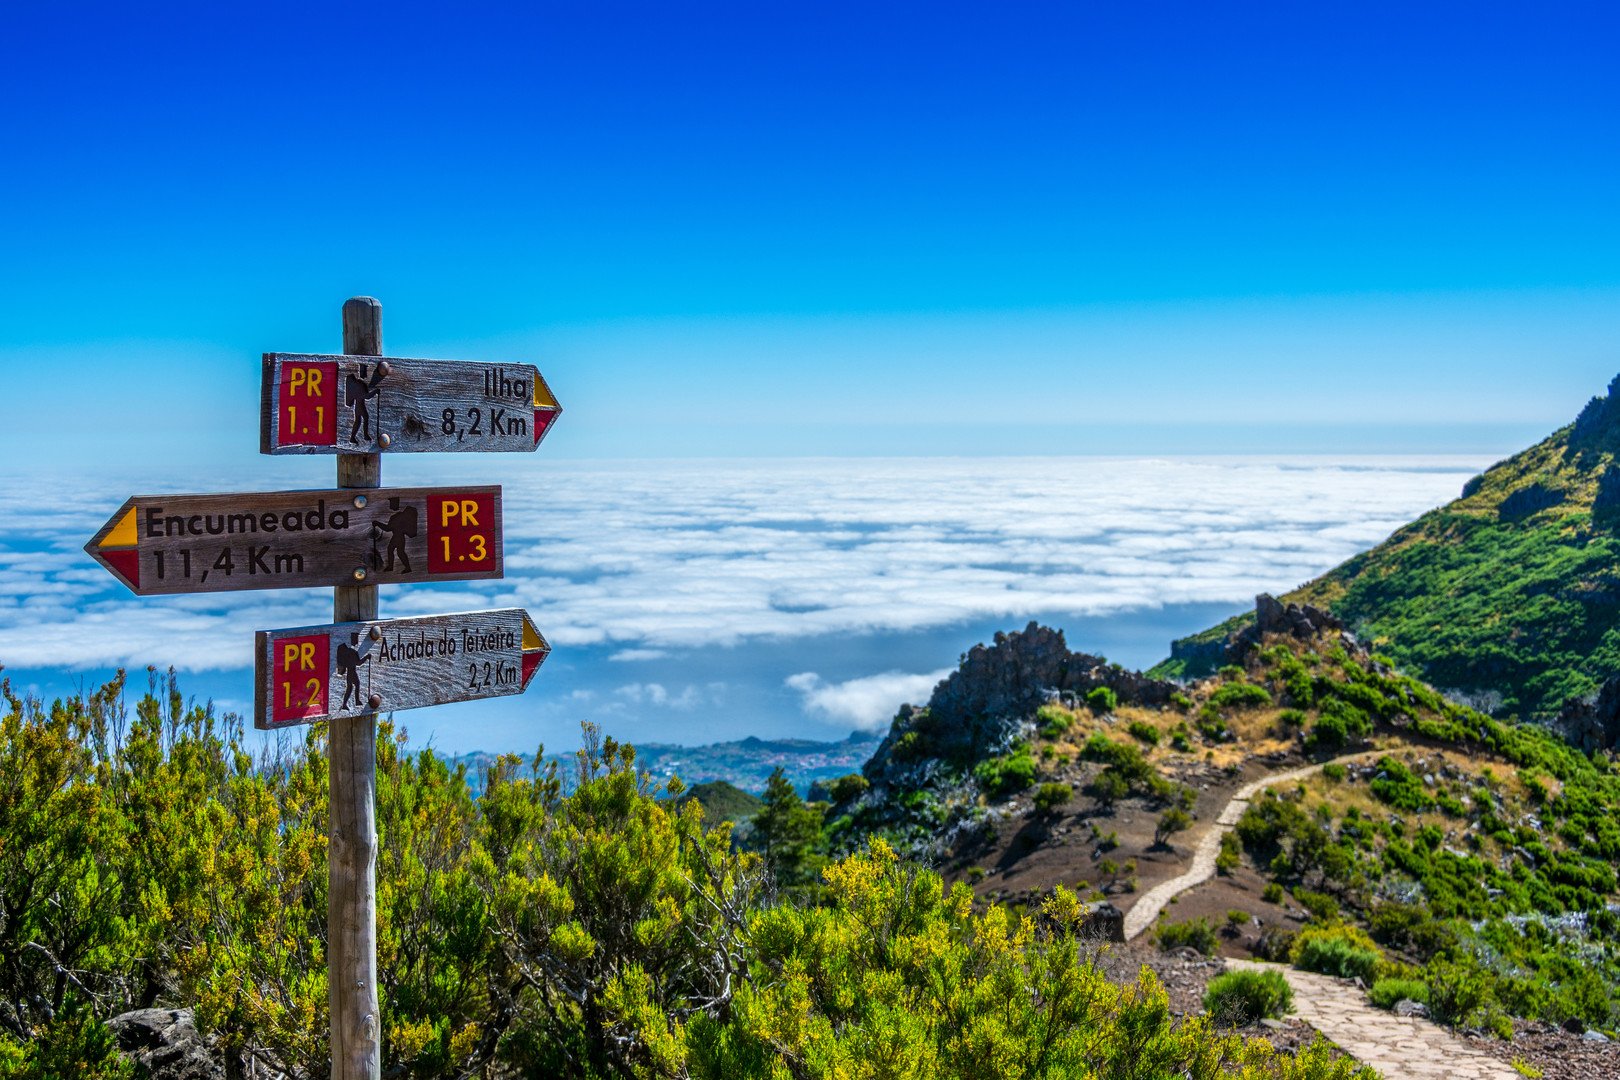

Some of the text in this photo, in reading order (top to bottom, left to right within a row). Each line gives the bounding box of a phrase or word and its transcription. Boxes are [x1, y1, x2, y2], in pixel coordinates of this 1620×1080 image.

[290, 367, 322, 397] PR
[288, 406, 324, 434] 1.1
[441, 407, 527, 441] 8,2 Km
[146, 500, 349, 538] Encumeada
[441, 500, 480, 528] PR
[153, 545, 304, 583] 11,4 Km
[440, 535, 488, 563] 1.3
[284, 642, 316, 672] PR
[378, 626, 514, 663] Achada do Teixeira
[469, 660, 517, 693] 2,2 Km
[282, 678, 321, 708] 1.2
